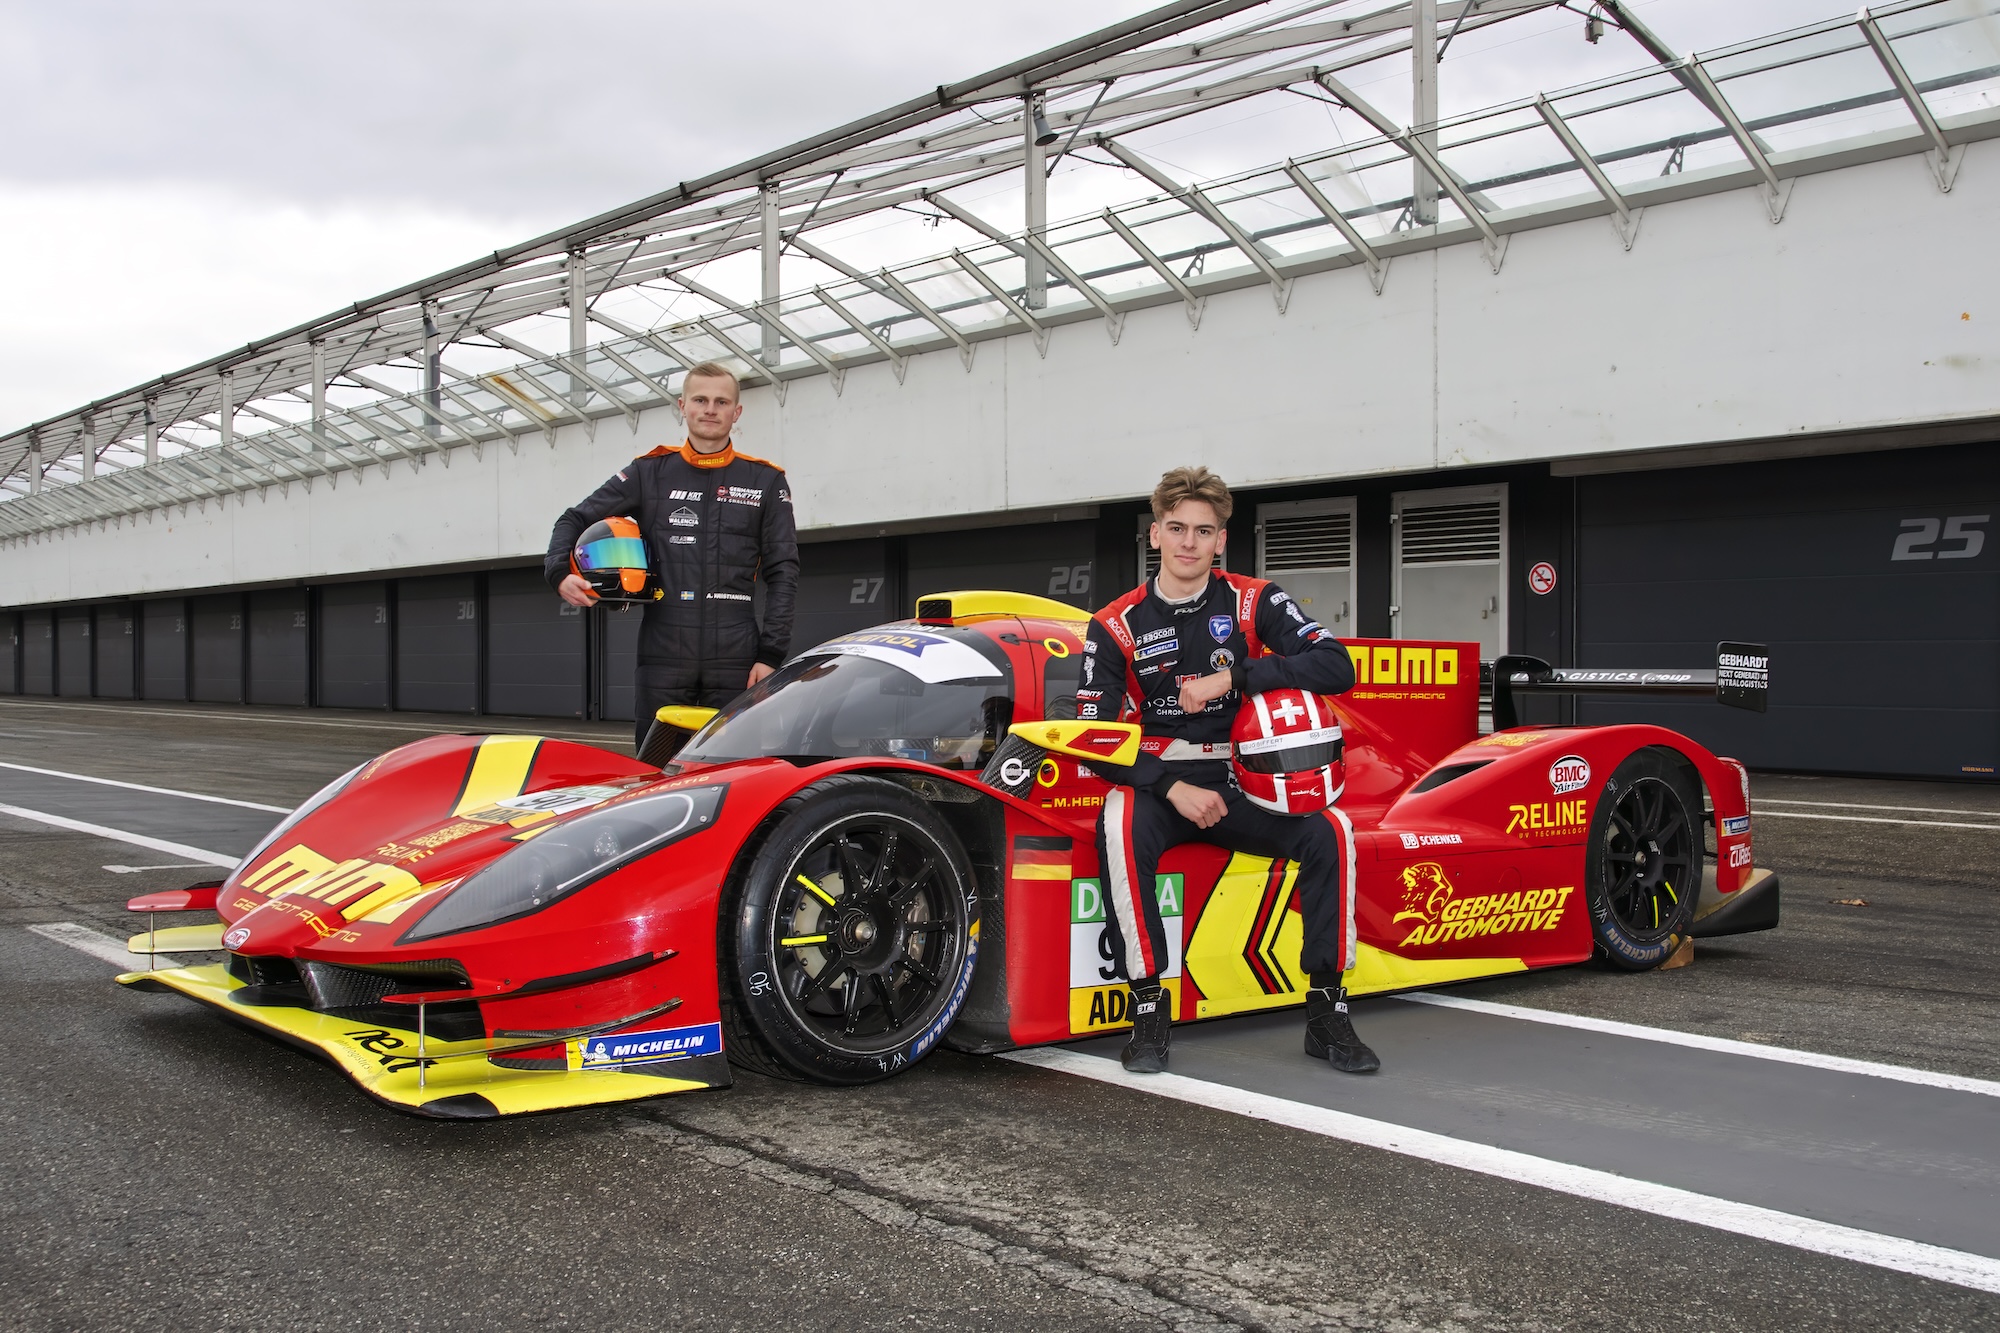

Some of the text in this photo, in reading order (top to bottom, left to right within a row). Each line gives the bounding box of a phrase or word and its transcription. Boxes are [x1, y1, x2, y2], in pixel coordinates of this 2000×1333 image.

[1891, 514, 1990, 561] 25
[850, 578, 884, 603] 27
[1048, 565, 1091, 595] 26
[457, 601, 475, 620] 30
[1106, 617, 1132, 648] sparco
[1719, 653, 1768, 668] GEBHARDT
[1718, 670, 1734, 678] NEXT
[1718, 678, 1768, 689] INTRALOGISTICS
[1410, 692, 1446, 700] RACING
[1555, 765, 1586, 783] BMC
[1506, 800, 1587, 834] RELINE
[1420, 834, 1463, 846] SCHENKER
[1535, 827, 1587, 838] TECHNOLOGY
[1440, 886, 1575, 923] GEBHARDT
[1398, 908, 1565, 948] AUTOMOTIVE
[1606, 927, 1660, 961] MICHELIN
[916, 960, 974, 1054] MICHELIN
[613, 1035, 705, 1057] MICHELIN
